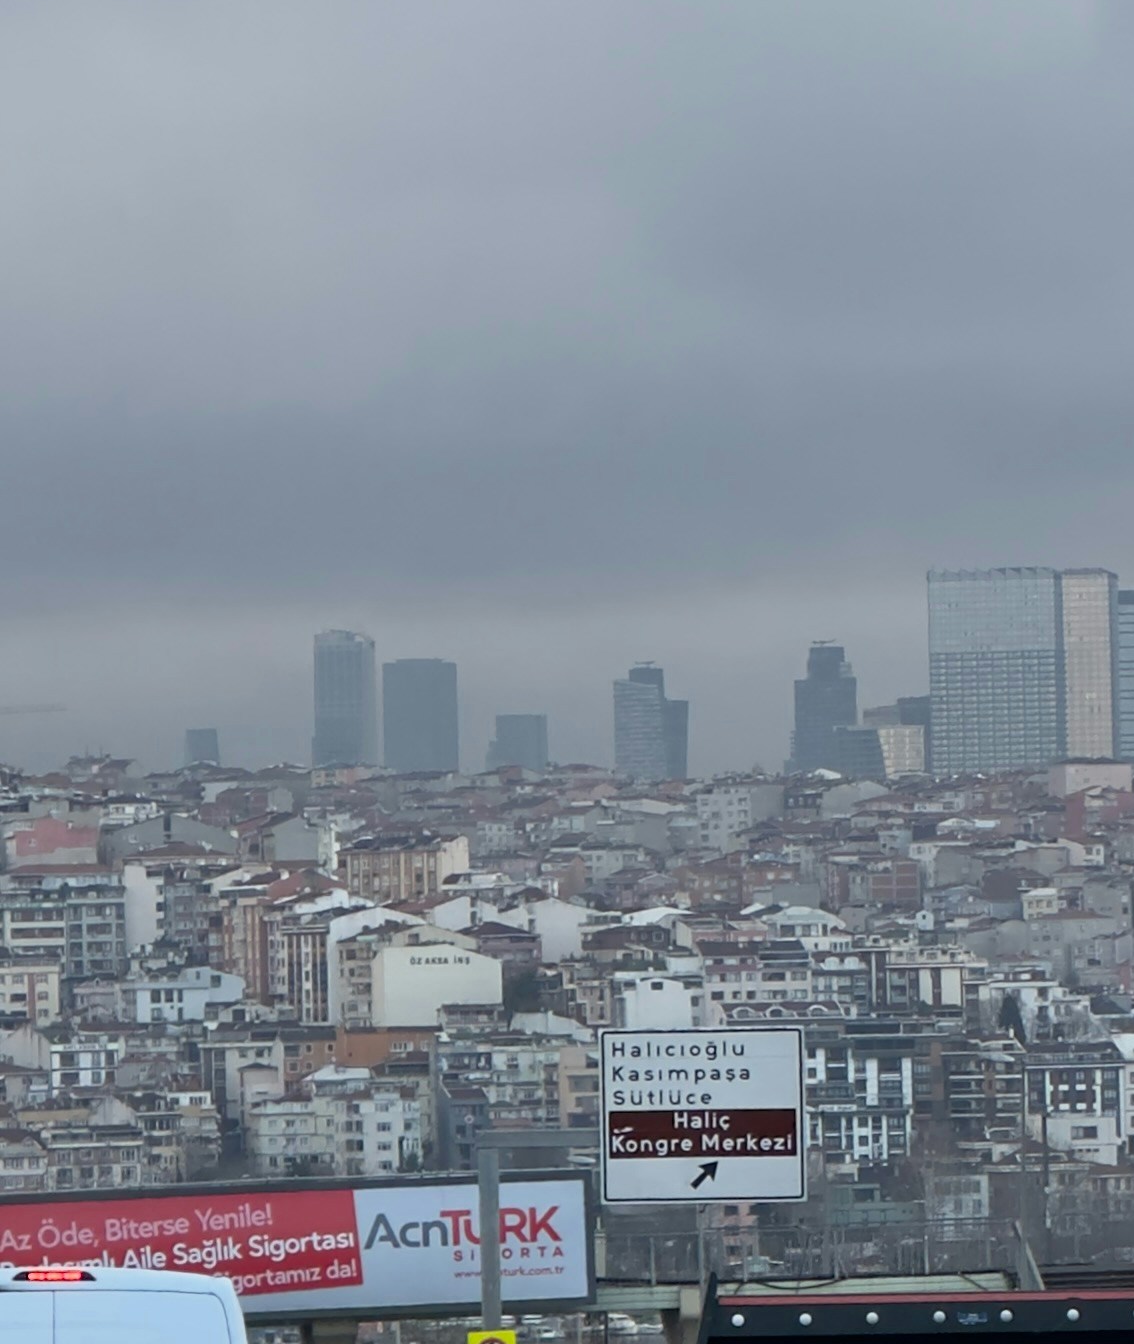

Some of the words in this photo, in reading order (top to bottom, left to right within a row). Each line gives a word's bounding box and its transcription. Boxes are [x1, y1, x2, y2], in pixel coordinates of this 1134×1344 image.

[611, 1041, 745, 1060] Halıcıoğlu
[612, 1065, 750, 1084] Kasımpaşa
[613, 1090, 712, 1106] Sütlüce
[673, 1111, 731, 1131] Haliç
[611, 1135, 693, 1156] Kongre
[701, 1134, 793, 1152] Merkezi
[0, 1229, 32, 1252] Az
[37, 1218, 99, 1248] Öde,
[105, 1217, 190, 1242] Biterse
[195, 1202, 273, 1232] Yenile!
[123, 1245, 167, 1269] Aile
[173, 1236, 242, 1269] Sağlık
[248, 1231, 355, 1262] Sigortası
[213, 1265, 321, 1295] gortamız
[326, 1258, 357, 1279] da!
